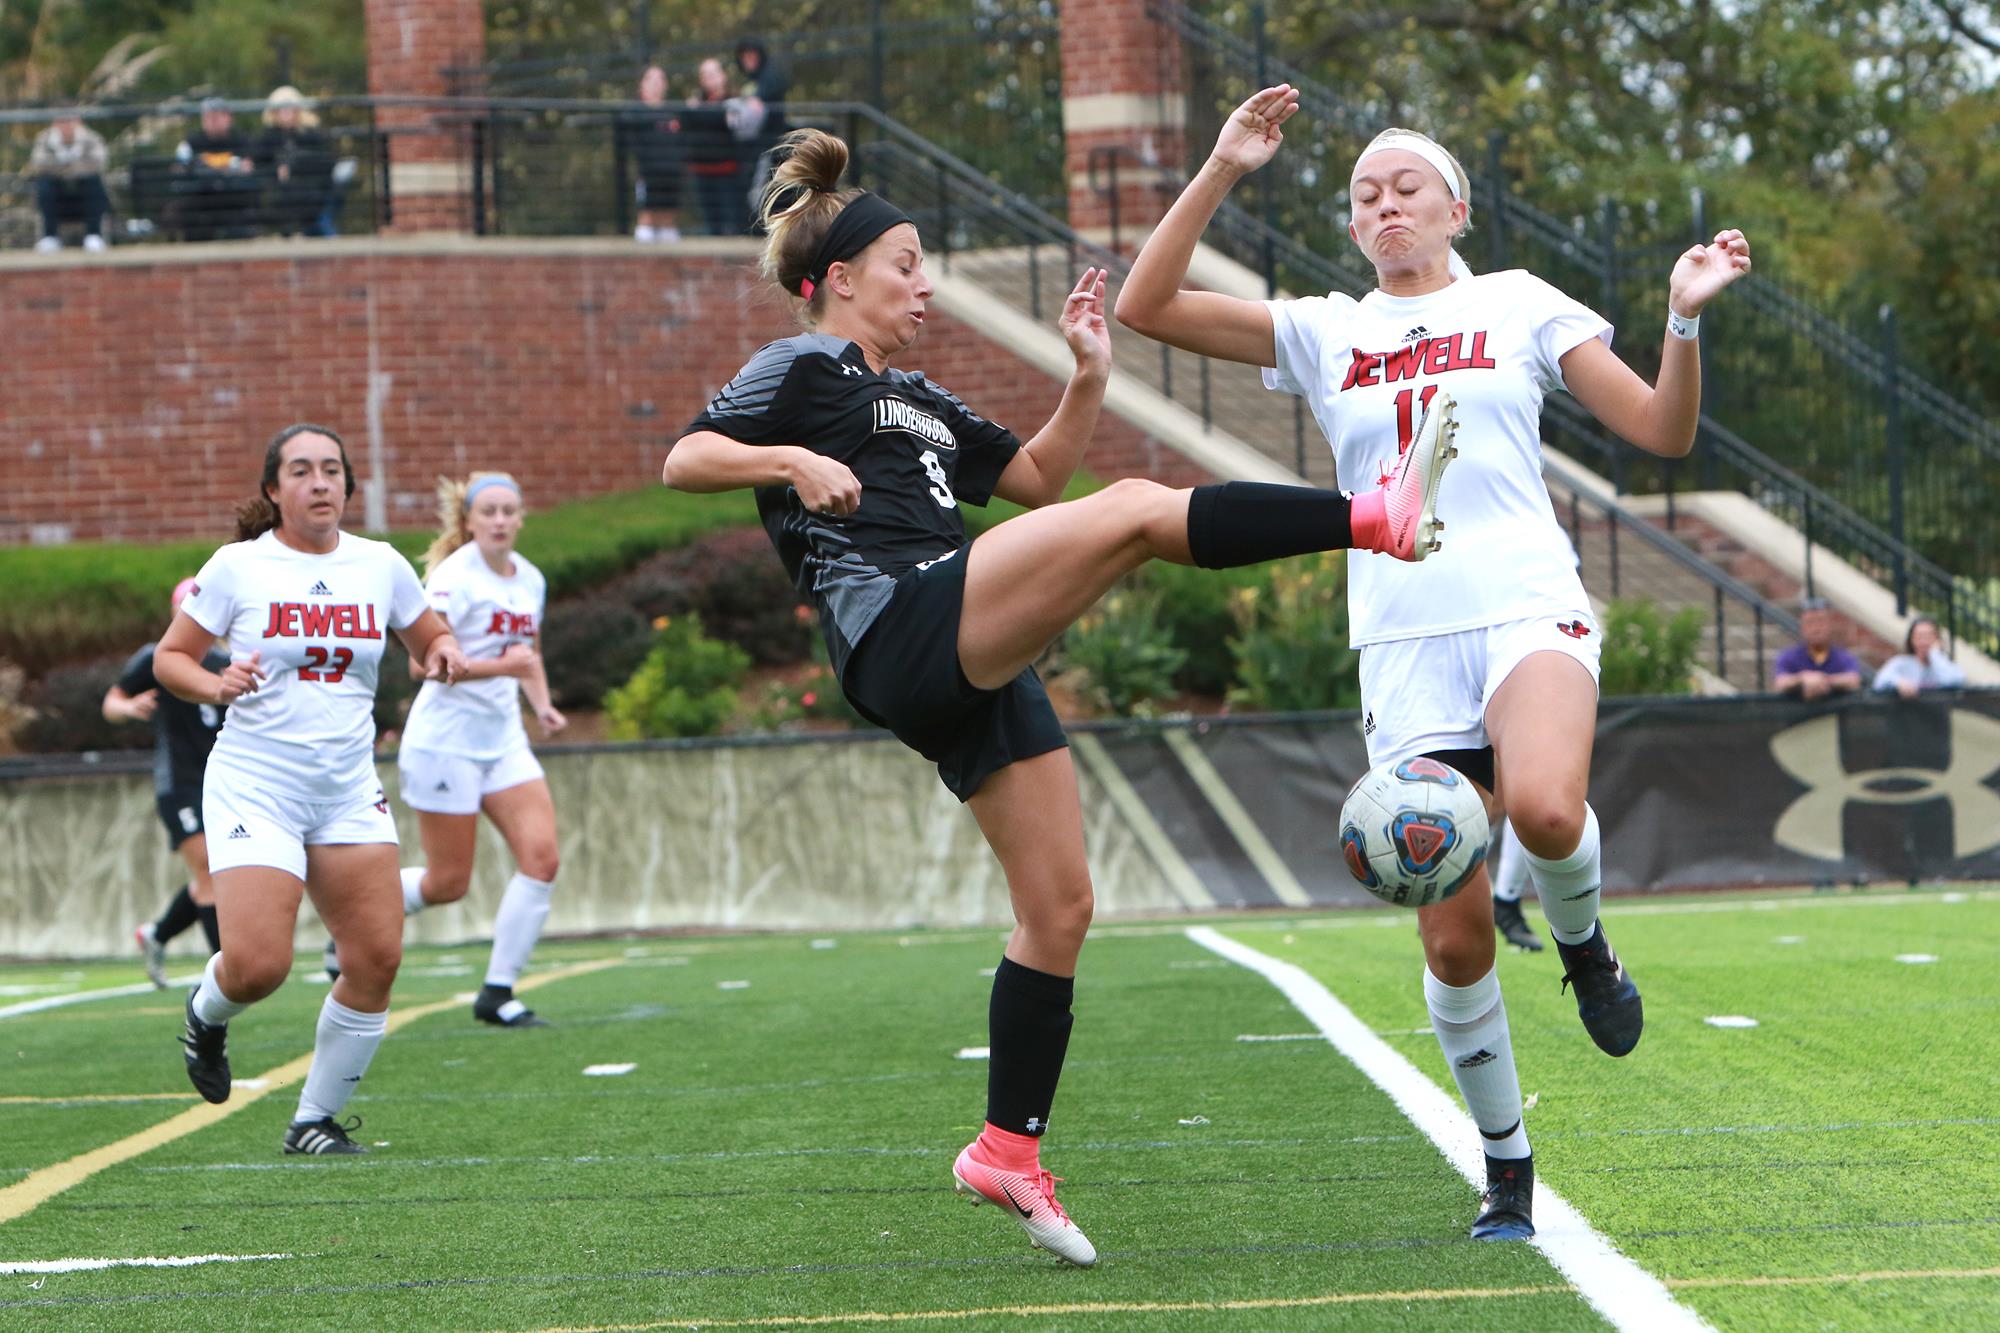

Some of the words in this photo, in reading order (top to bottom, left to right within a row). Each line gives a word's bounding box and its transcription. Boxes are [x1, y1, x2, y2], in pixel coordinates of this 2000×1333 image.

[1341, 330, 1496, 392] JEWELL
[262, 602, 382, 639] JEWELL
[298, 646, 354, 683] 23
